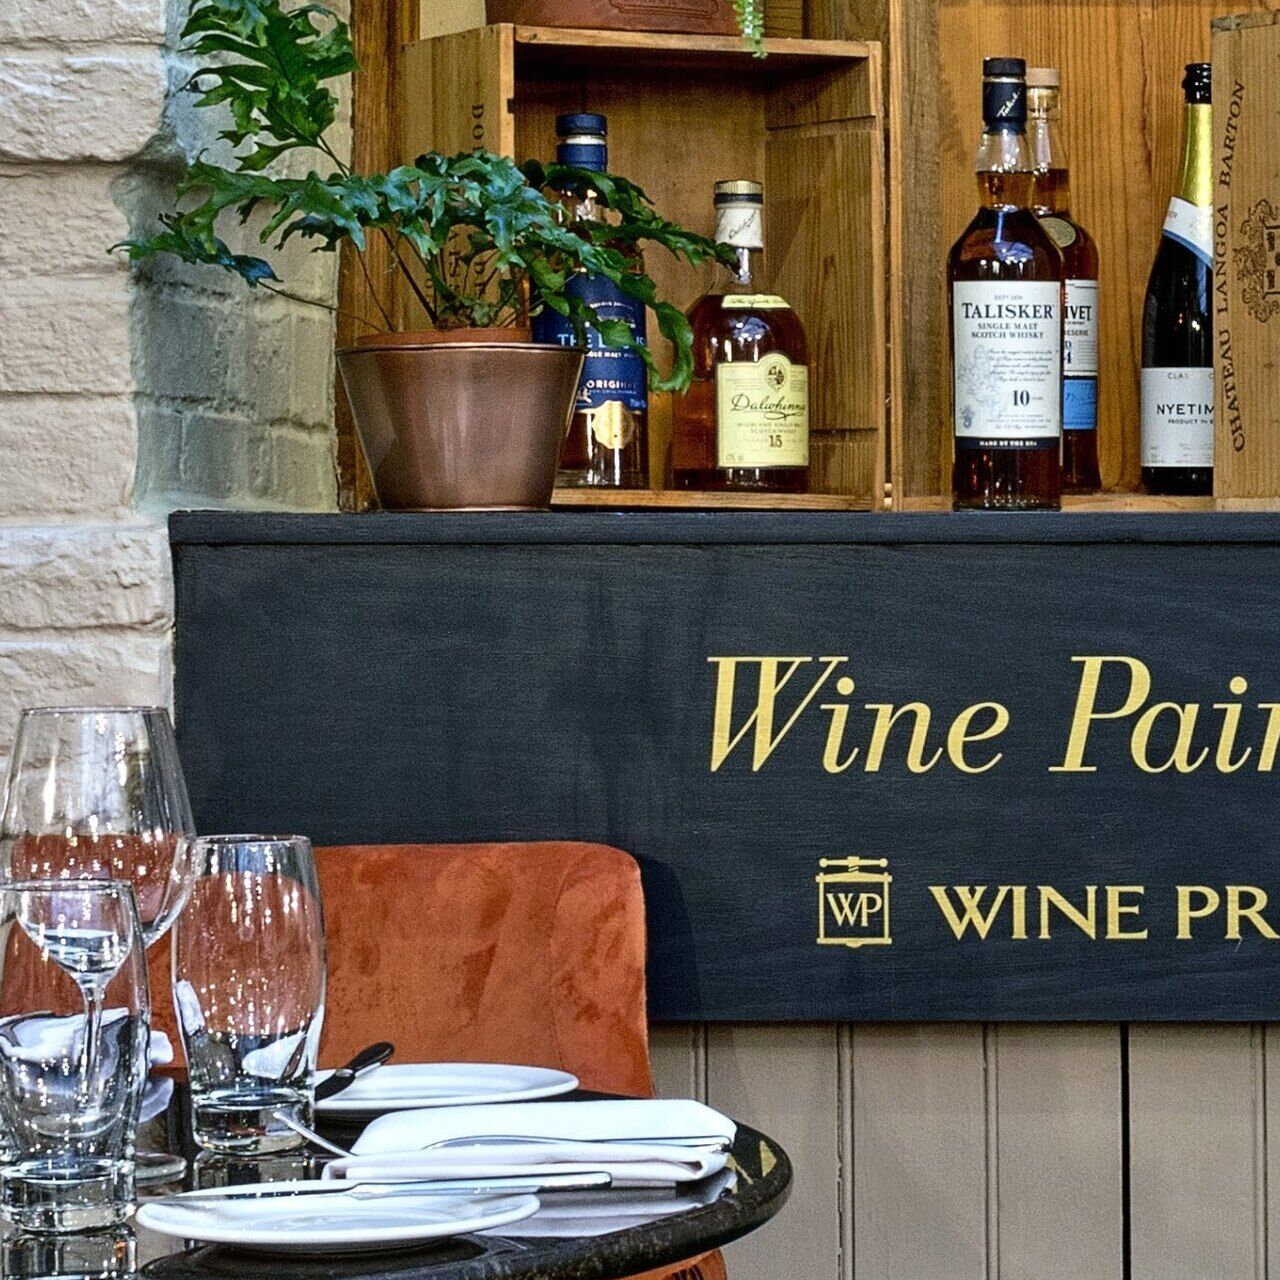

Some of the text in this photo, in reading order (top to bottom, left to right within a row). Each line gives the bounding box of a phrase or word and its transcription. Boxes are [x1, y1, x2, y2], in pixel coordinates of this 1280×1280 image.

[1215, 80, 1245, 452] CHATEAU LANGOA BARTON
[961, 302, 1054, 319] TALISKER
[977, 322, 1038, 330] SINGLE MALT
[971, 331, 1044, 339] SCOTCH WHISKY
[1012, 389, 1030, 407] 10
[1156, 403, 1215, 416] NYETIM
[770, 434, 783, 447] 15
[707, 655, 1010, 773] Wine
[825, 892, 883, 927] WP
[927, 884, 1146, 941] WINE
